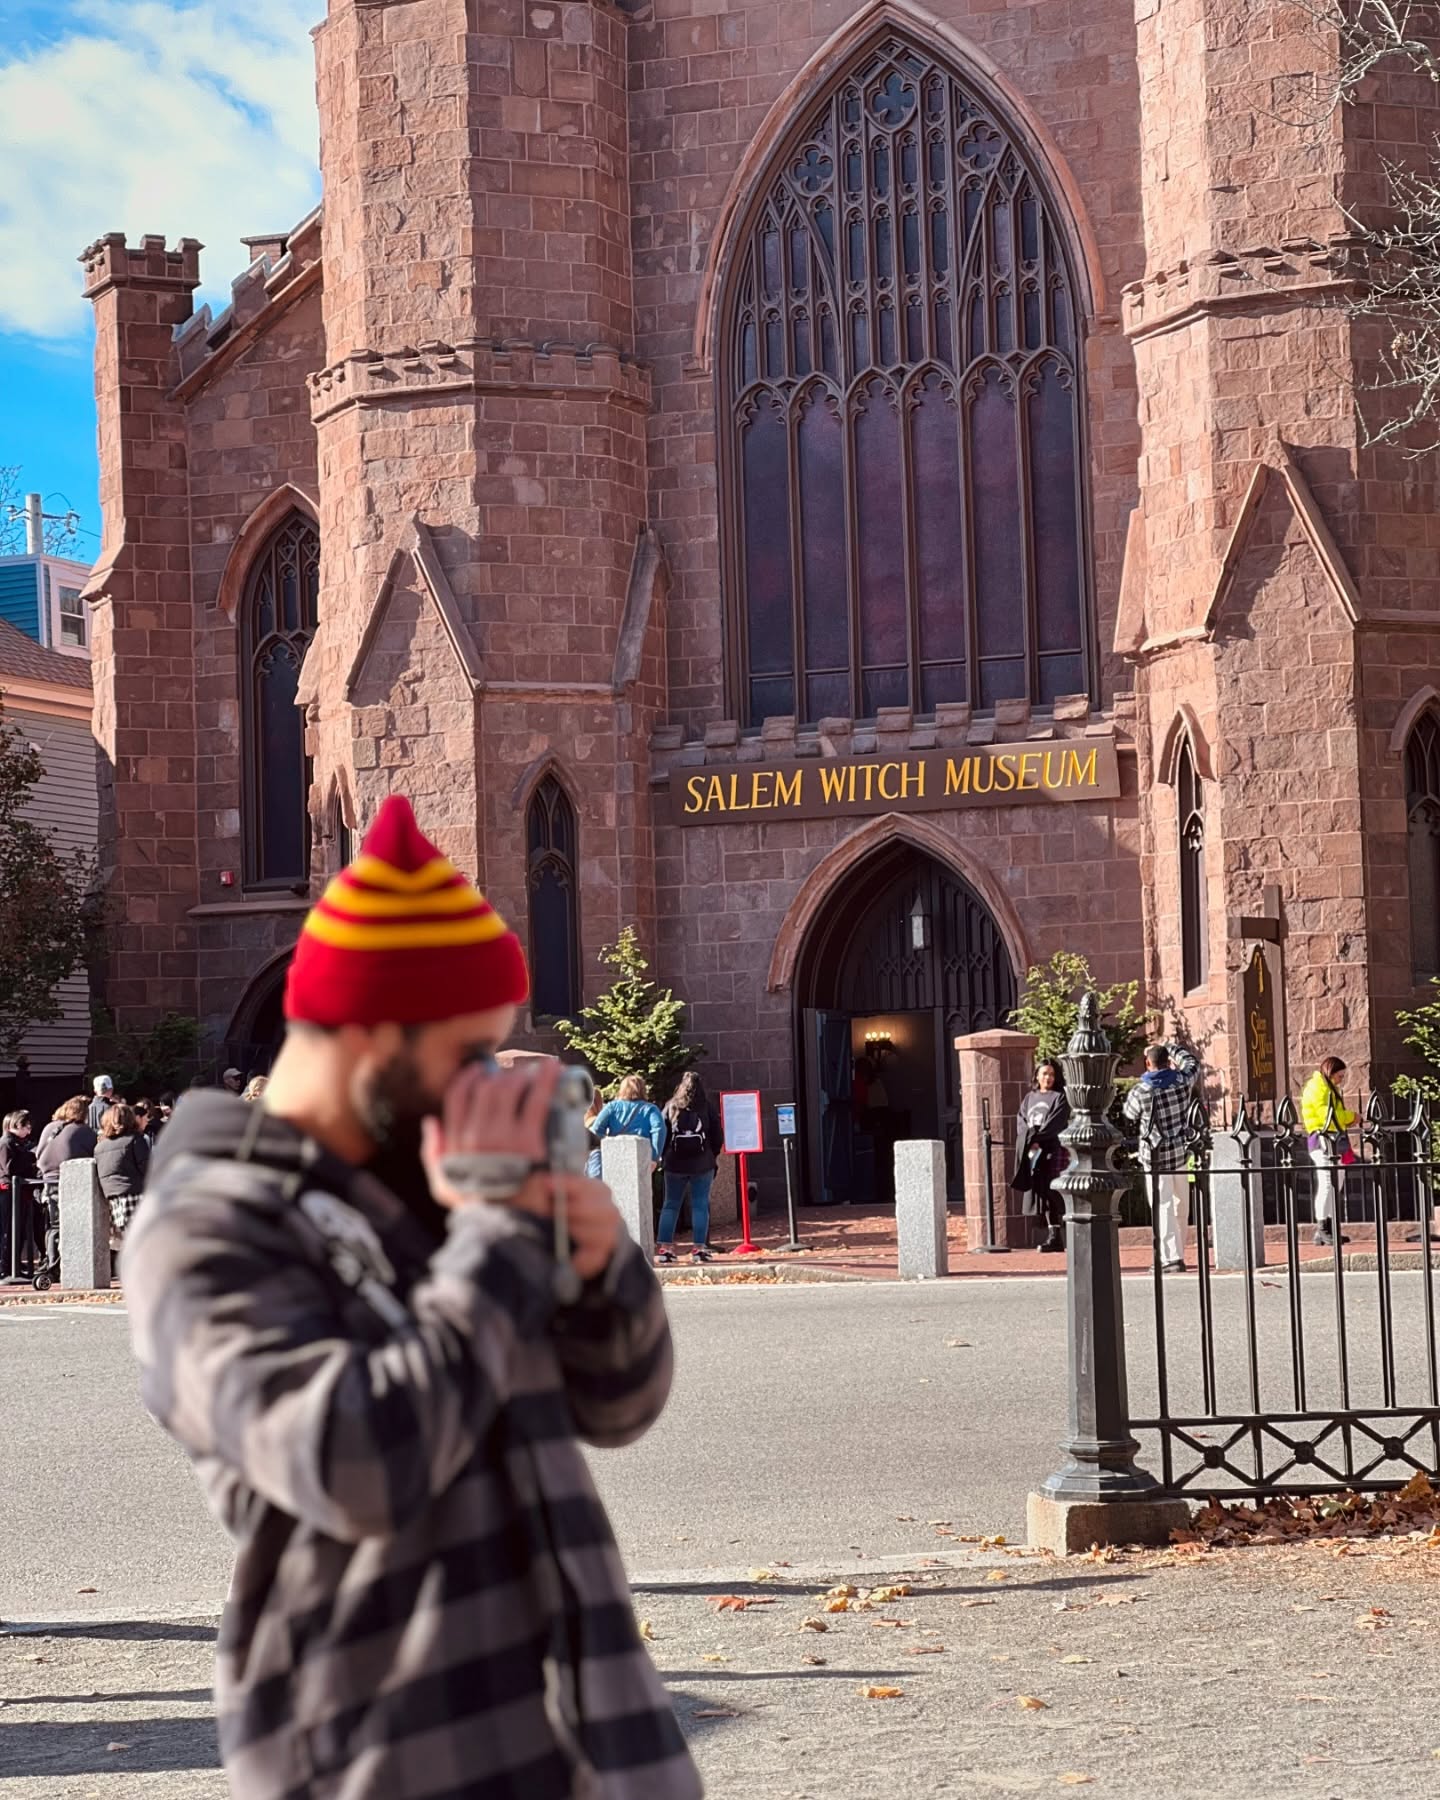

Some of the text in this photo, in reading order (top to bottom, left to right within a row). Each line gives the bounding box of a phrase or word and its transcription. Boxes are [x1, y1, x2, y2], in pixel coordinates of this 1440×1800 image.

[684, 747, 1099, 813] SALEM WITCH MUSEUM
